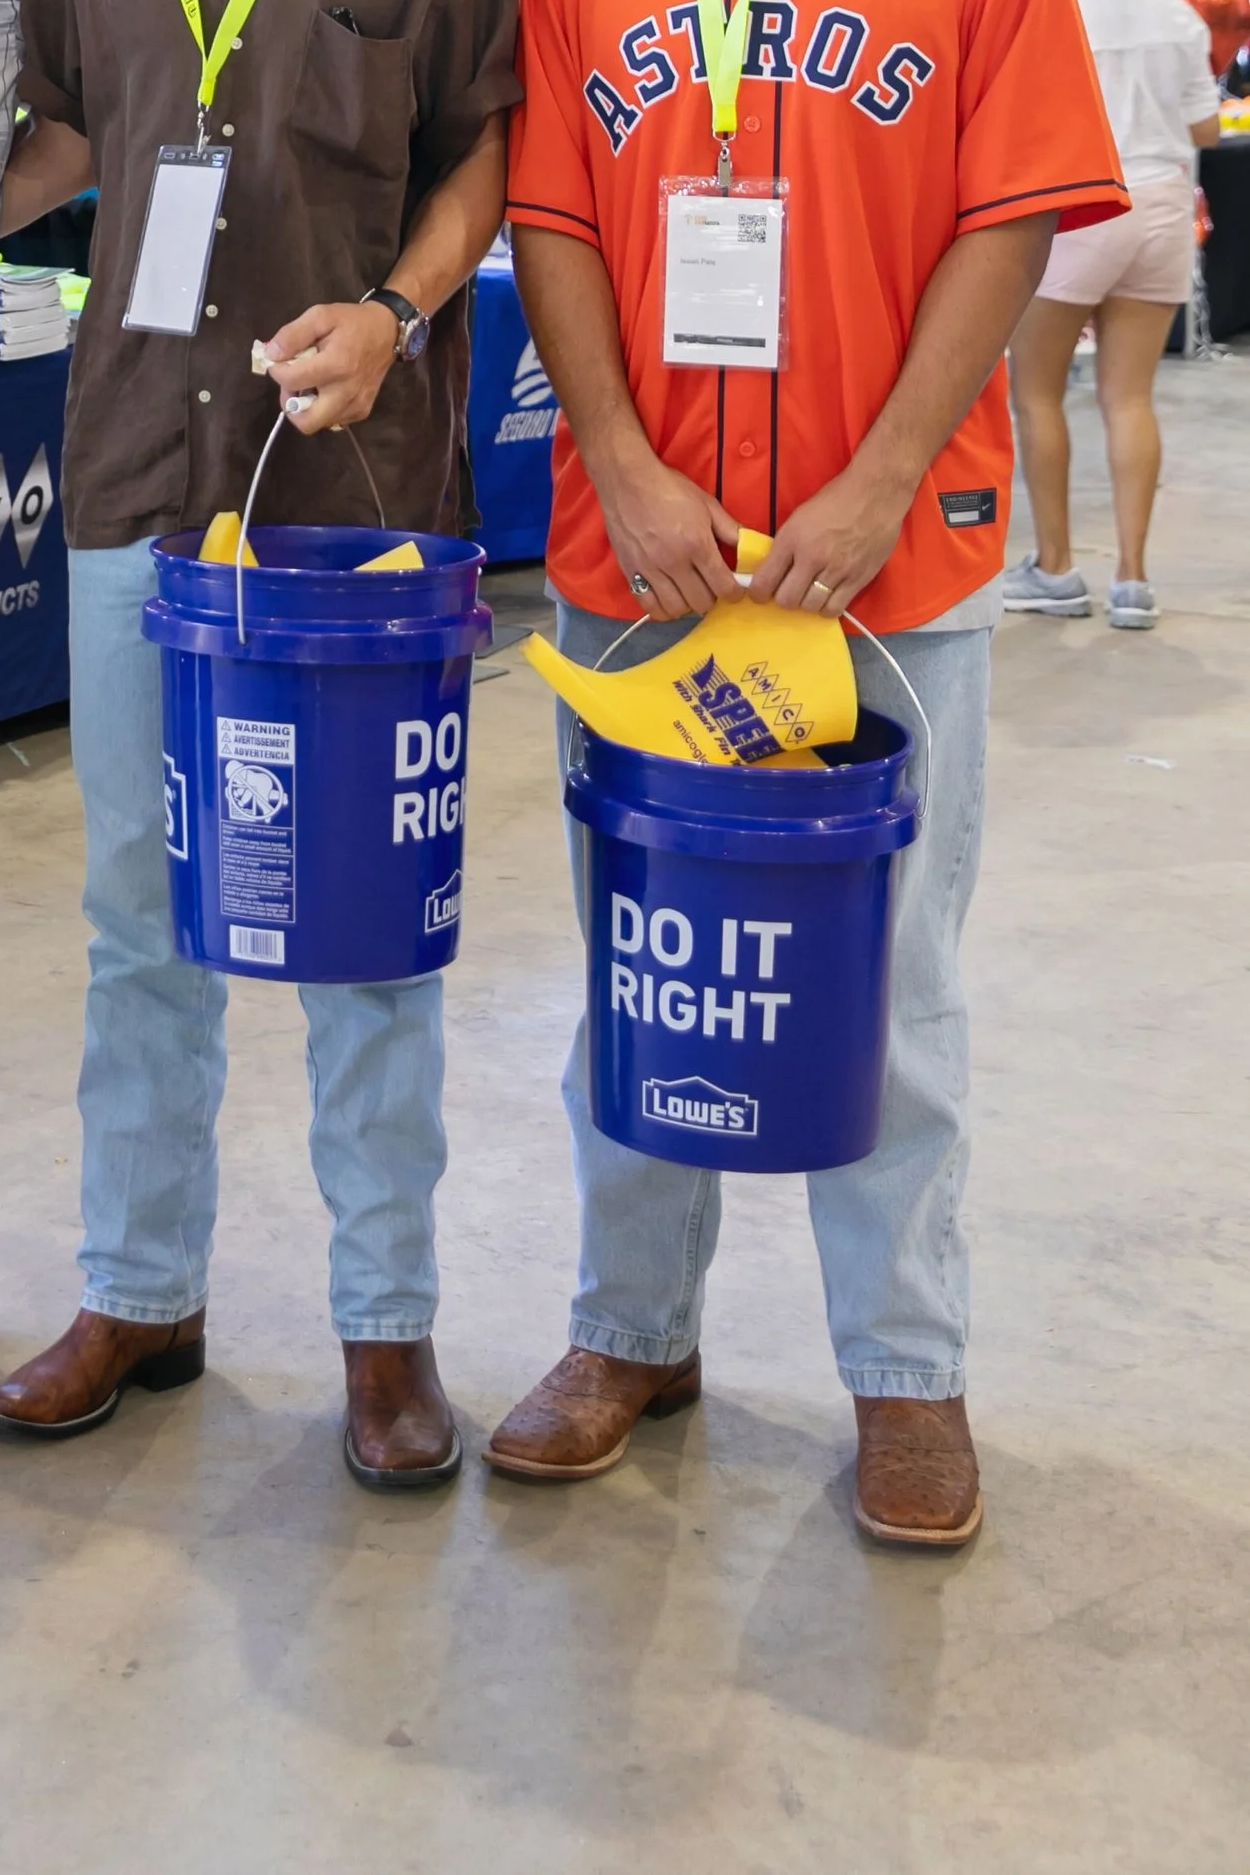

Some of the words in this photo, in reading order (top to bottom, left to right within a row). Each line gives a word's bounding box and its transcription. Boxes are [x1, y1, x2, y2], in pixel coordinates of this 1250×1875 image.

[233, 721, 290, 736] WARNING
[690, 704, 717, 734] Shark
[714, 736, 732, 757] Fin
[697, 681, 786, 764] SPEE
[747, 666, 806, 740] AMICO
[233, 734, 290, 748] AVERTISSEMENT
[233, 746, 290, 761] ADVERTENCIA
[395, 712, 461, 780] DO
[611, 891, 694, 968] DO
[721, 918, 793, 979] IT
[611, 961, 792, 1042] RIGHT
[653, 1087, 746, 1130] LOWE'S
